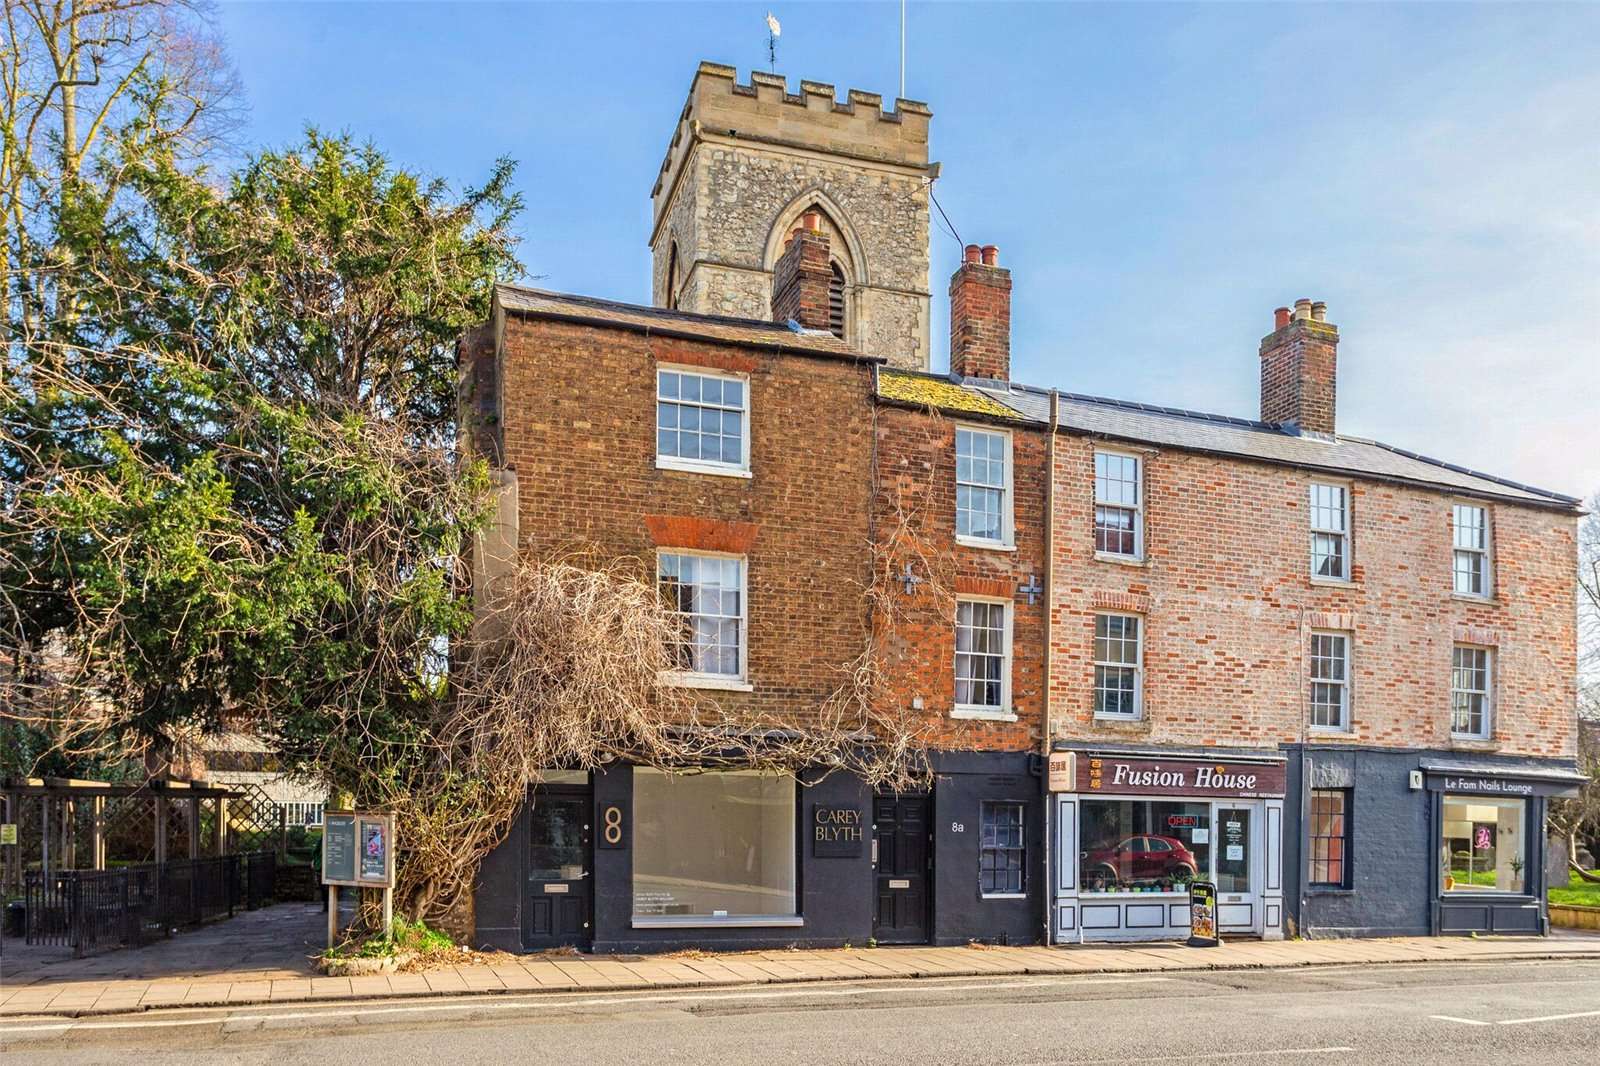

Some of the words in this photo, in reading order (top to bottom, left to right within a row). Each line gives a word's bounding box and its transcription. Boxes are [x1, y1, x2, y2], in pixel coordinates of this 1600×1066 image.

[1112, 764, 1185, 787] Fusion
[1194, 767, 1257, 789] House
[1445, 778, 1456, 789] Le
[1458, 779, 1477, 790] Fam
[1479, 780, 1500, 791] Nails
[1502, 781, 1533, 795] Lounge
[816, 809, 862, 824] CAREY
[1168, 815, 1195, 826] OPEN
[605, 807, 621, 843] 8
[952, 822, 964, 833] 8a
[815, 826, 862, 841] BLYTH
